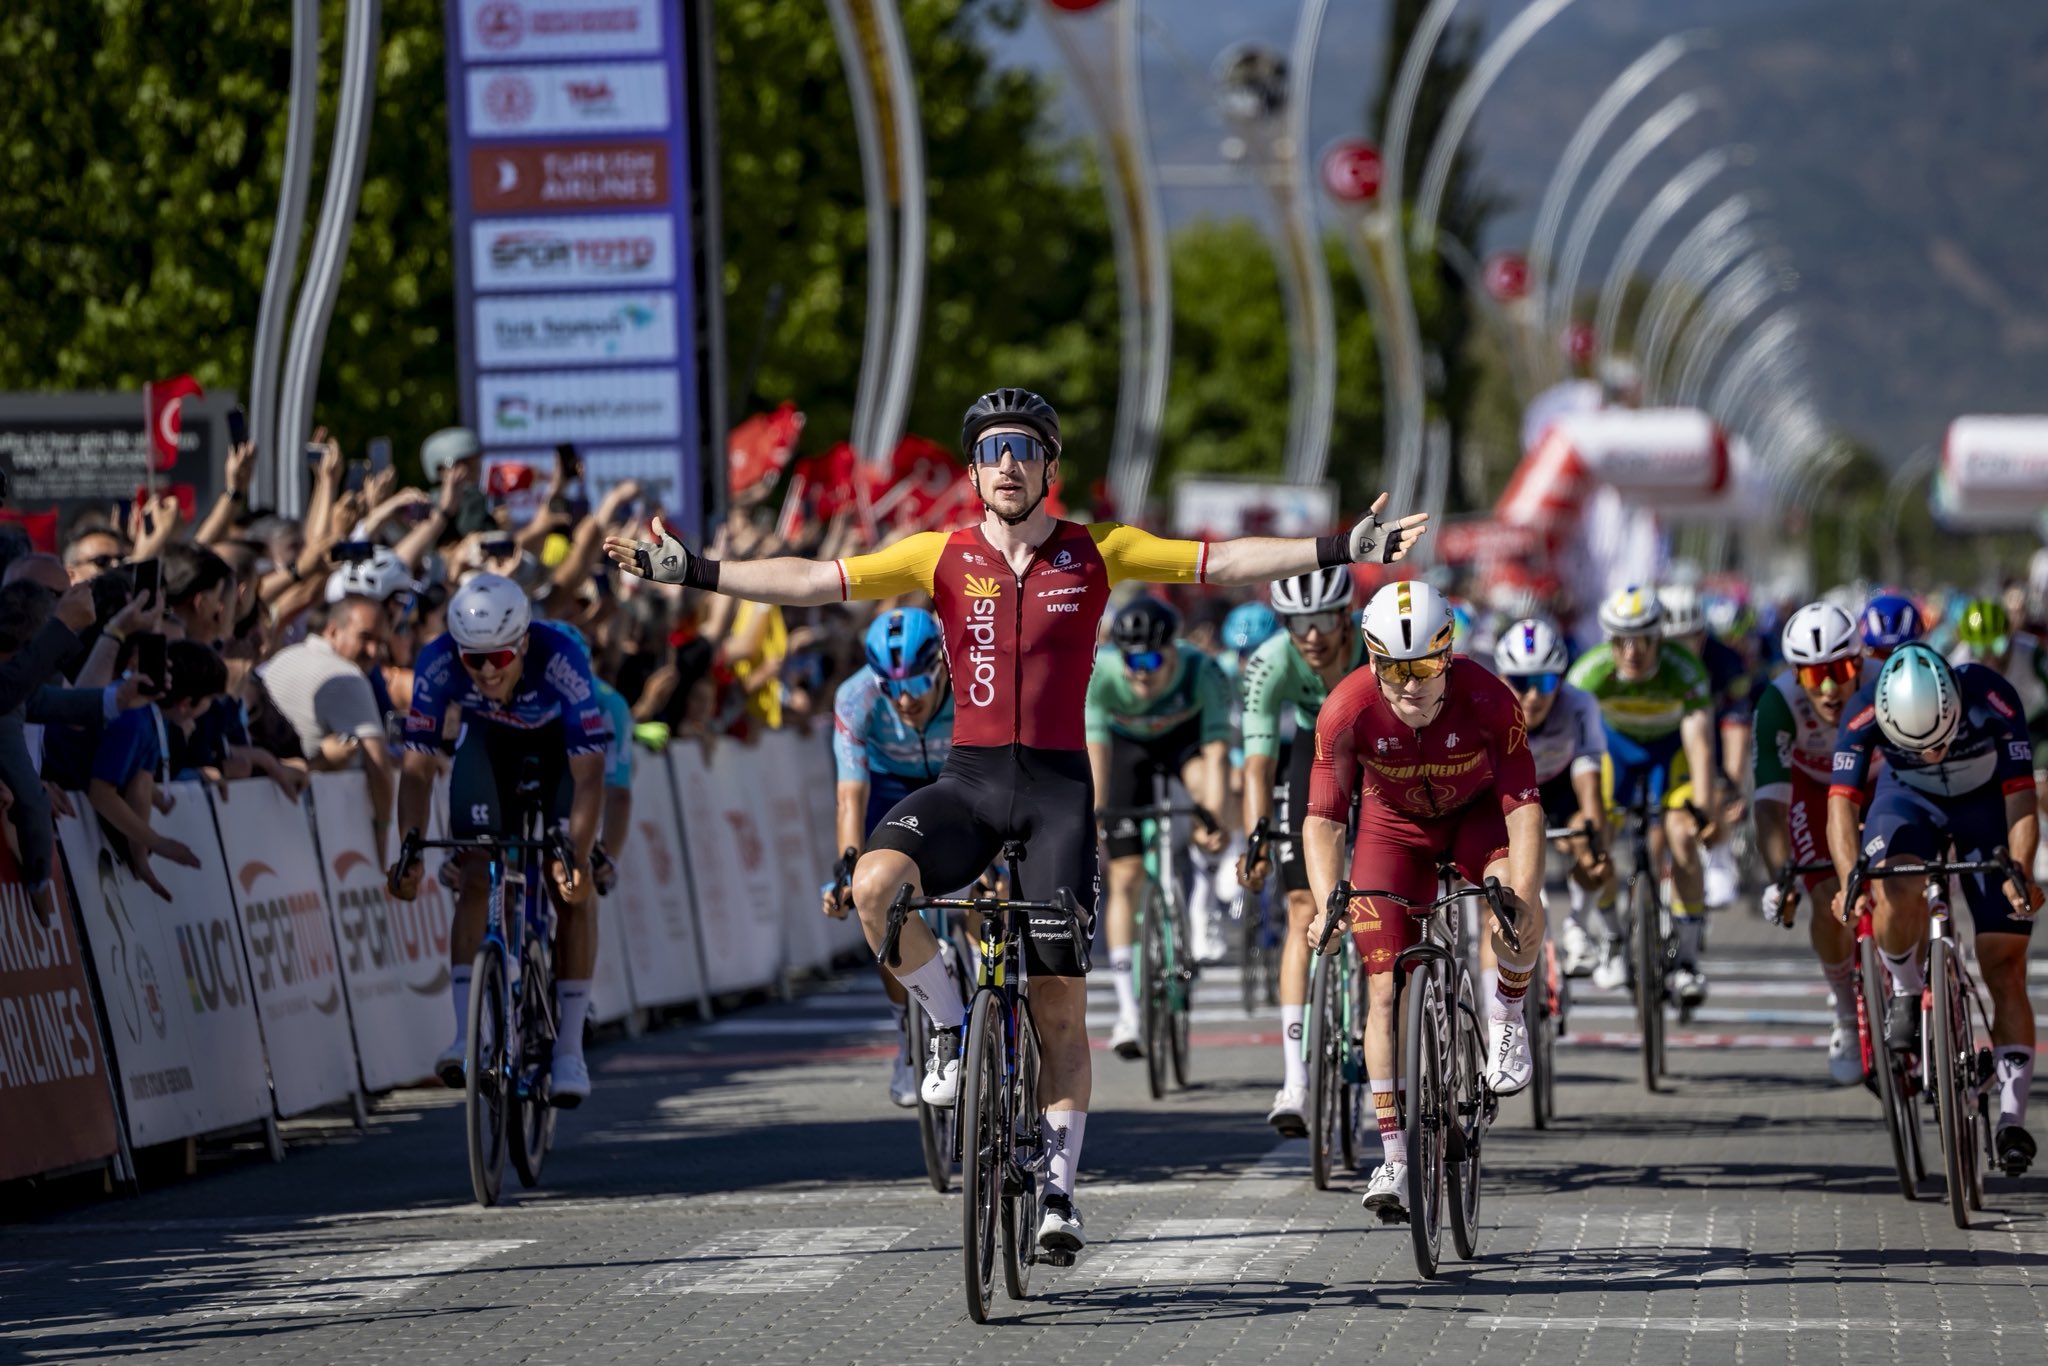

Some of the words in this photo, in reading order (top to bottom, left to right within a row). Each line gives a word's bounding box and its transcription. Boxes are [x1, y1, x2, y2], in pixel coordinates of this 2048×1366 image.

[1037, 586, 1089, 598] LOOK
[1047, 602, 1080, 612] uvex
[966, 598, 996, 707] Cofidis
[185, 918, 247, 1012] UCI
[988, 933, 996, 976] LOOK
